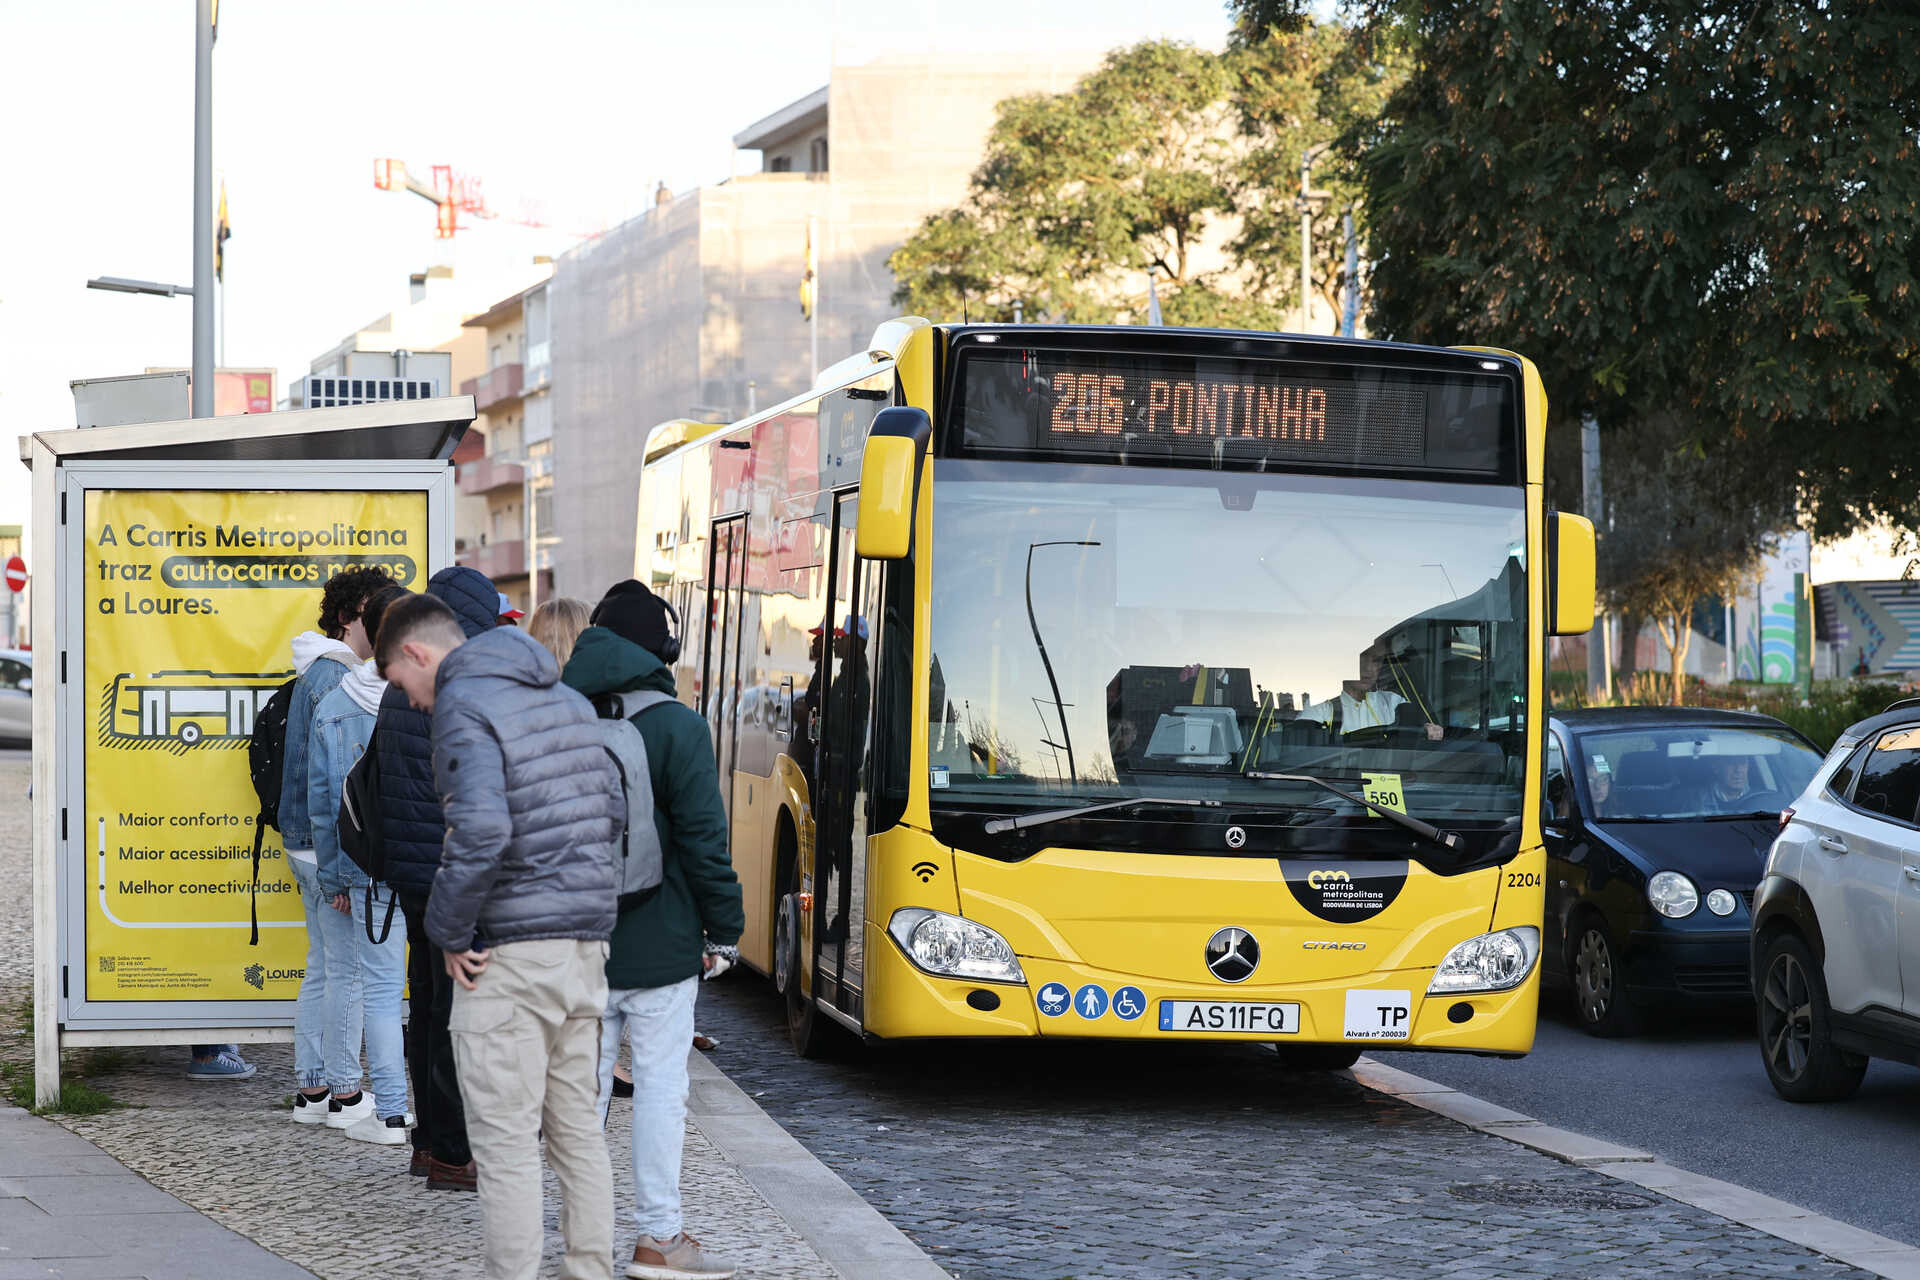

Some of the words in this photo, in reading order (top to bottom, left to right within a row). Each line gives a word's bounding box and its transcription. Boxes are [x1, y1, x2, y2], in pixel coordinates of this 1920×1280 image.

[1051, 372, 1125, 435] 206
[1148, 380, 1327, 441] PONTINHA
[98, 524, 118, 546] A
[126, 523, 207, 547] Carris
[215, 523, 407, 552] Metropolitana
[98, 559, 152, 581] traz
[171, 559, 320, 582] autocarros
[98, 598, 115, 614] a
[125, 592, 219, 615] Loures.
[1370, 791, 1398, 806] 550
[119, 812, 165, 826] Maior
[169, 812, 239, 826] conforto
[243, 815, 253, 826] e
[119, 846, 165, 860] Maior
[169, 845, 282, 860] acessibilidde
[119, 880, 174, 894] Melhor
[178, 879, 292, 893] conectividade
[1323, 883, 1354, 891] carris
[1508, 872, 1541, 888] 2204
[1323, 890, 1384, 899] metropolitana
[1303, 941, 1366, 951] CITARO
[266, 969, 305, 979] LOURE
[1377, 1006, 1408, 1027] TP
